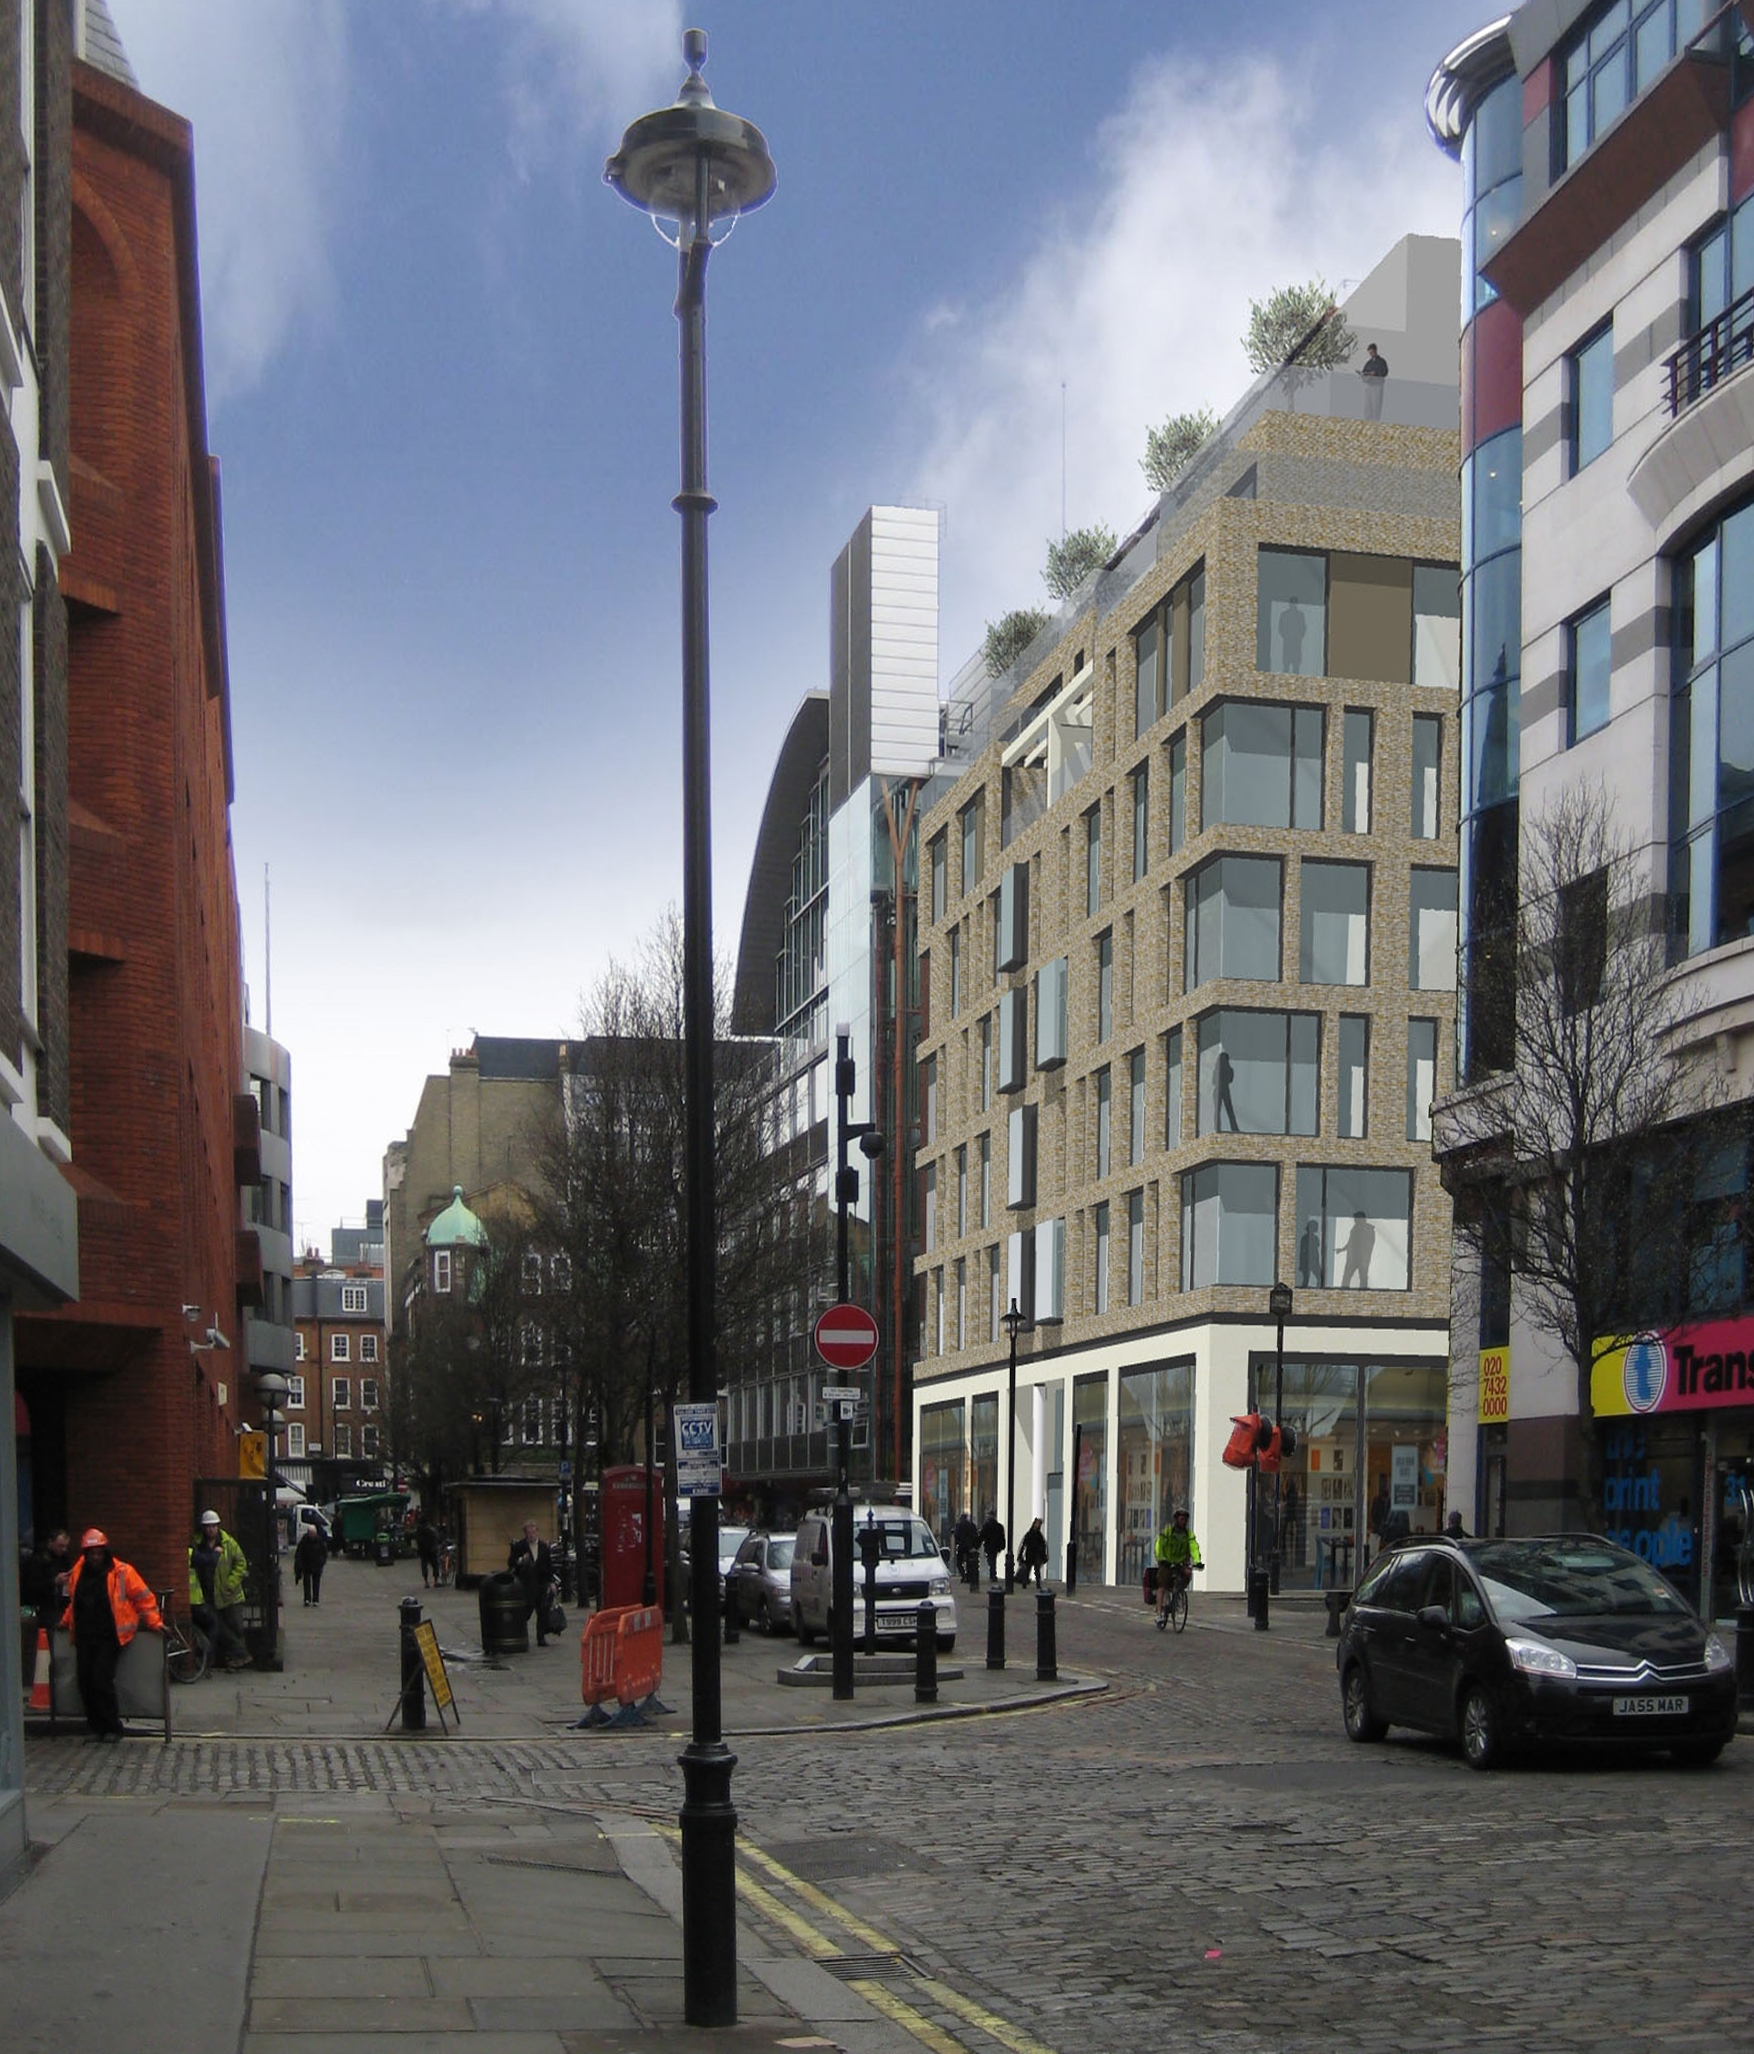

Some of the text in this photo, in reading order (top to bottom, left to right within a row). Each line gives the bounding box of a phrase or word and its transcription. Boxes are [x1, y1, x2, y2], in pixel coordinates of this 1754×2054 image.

[1484, 1355, 1502, 1377] 020
[1484, 1376, 1507, 1397] 7432
[1483, 1397, 1508, 1416] 0000
[681, 1421, 712, 1435] CCTV
[1657, 1698, 1684, 1712] MAR
